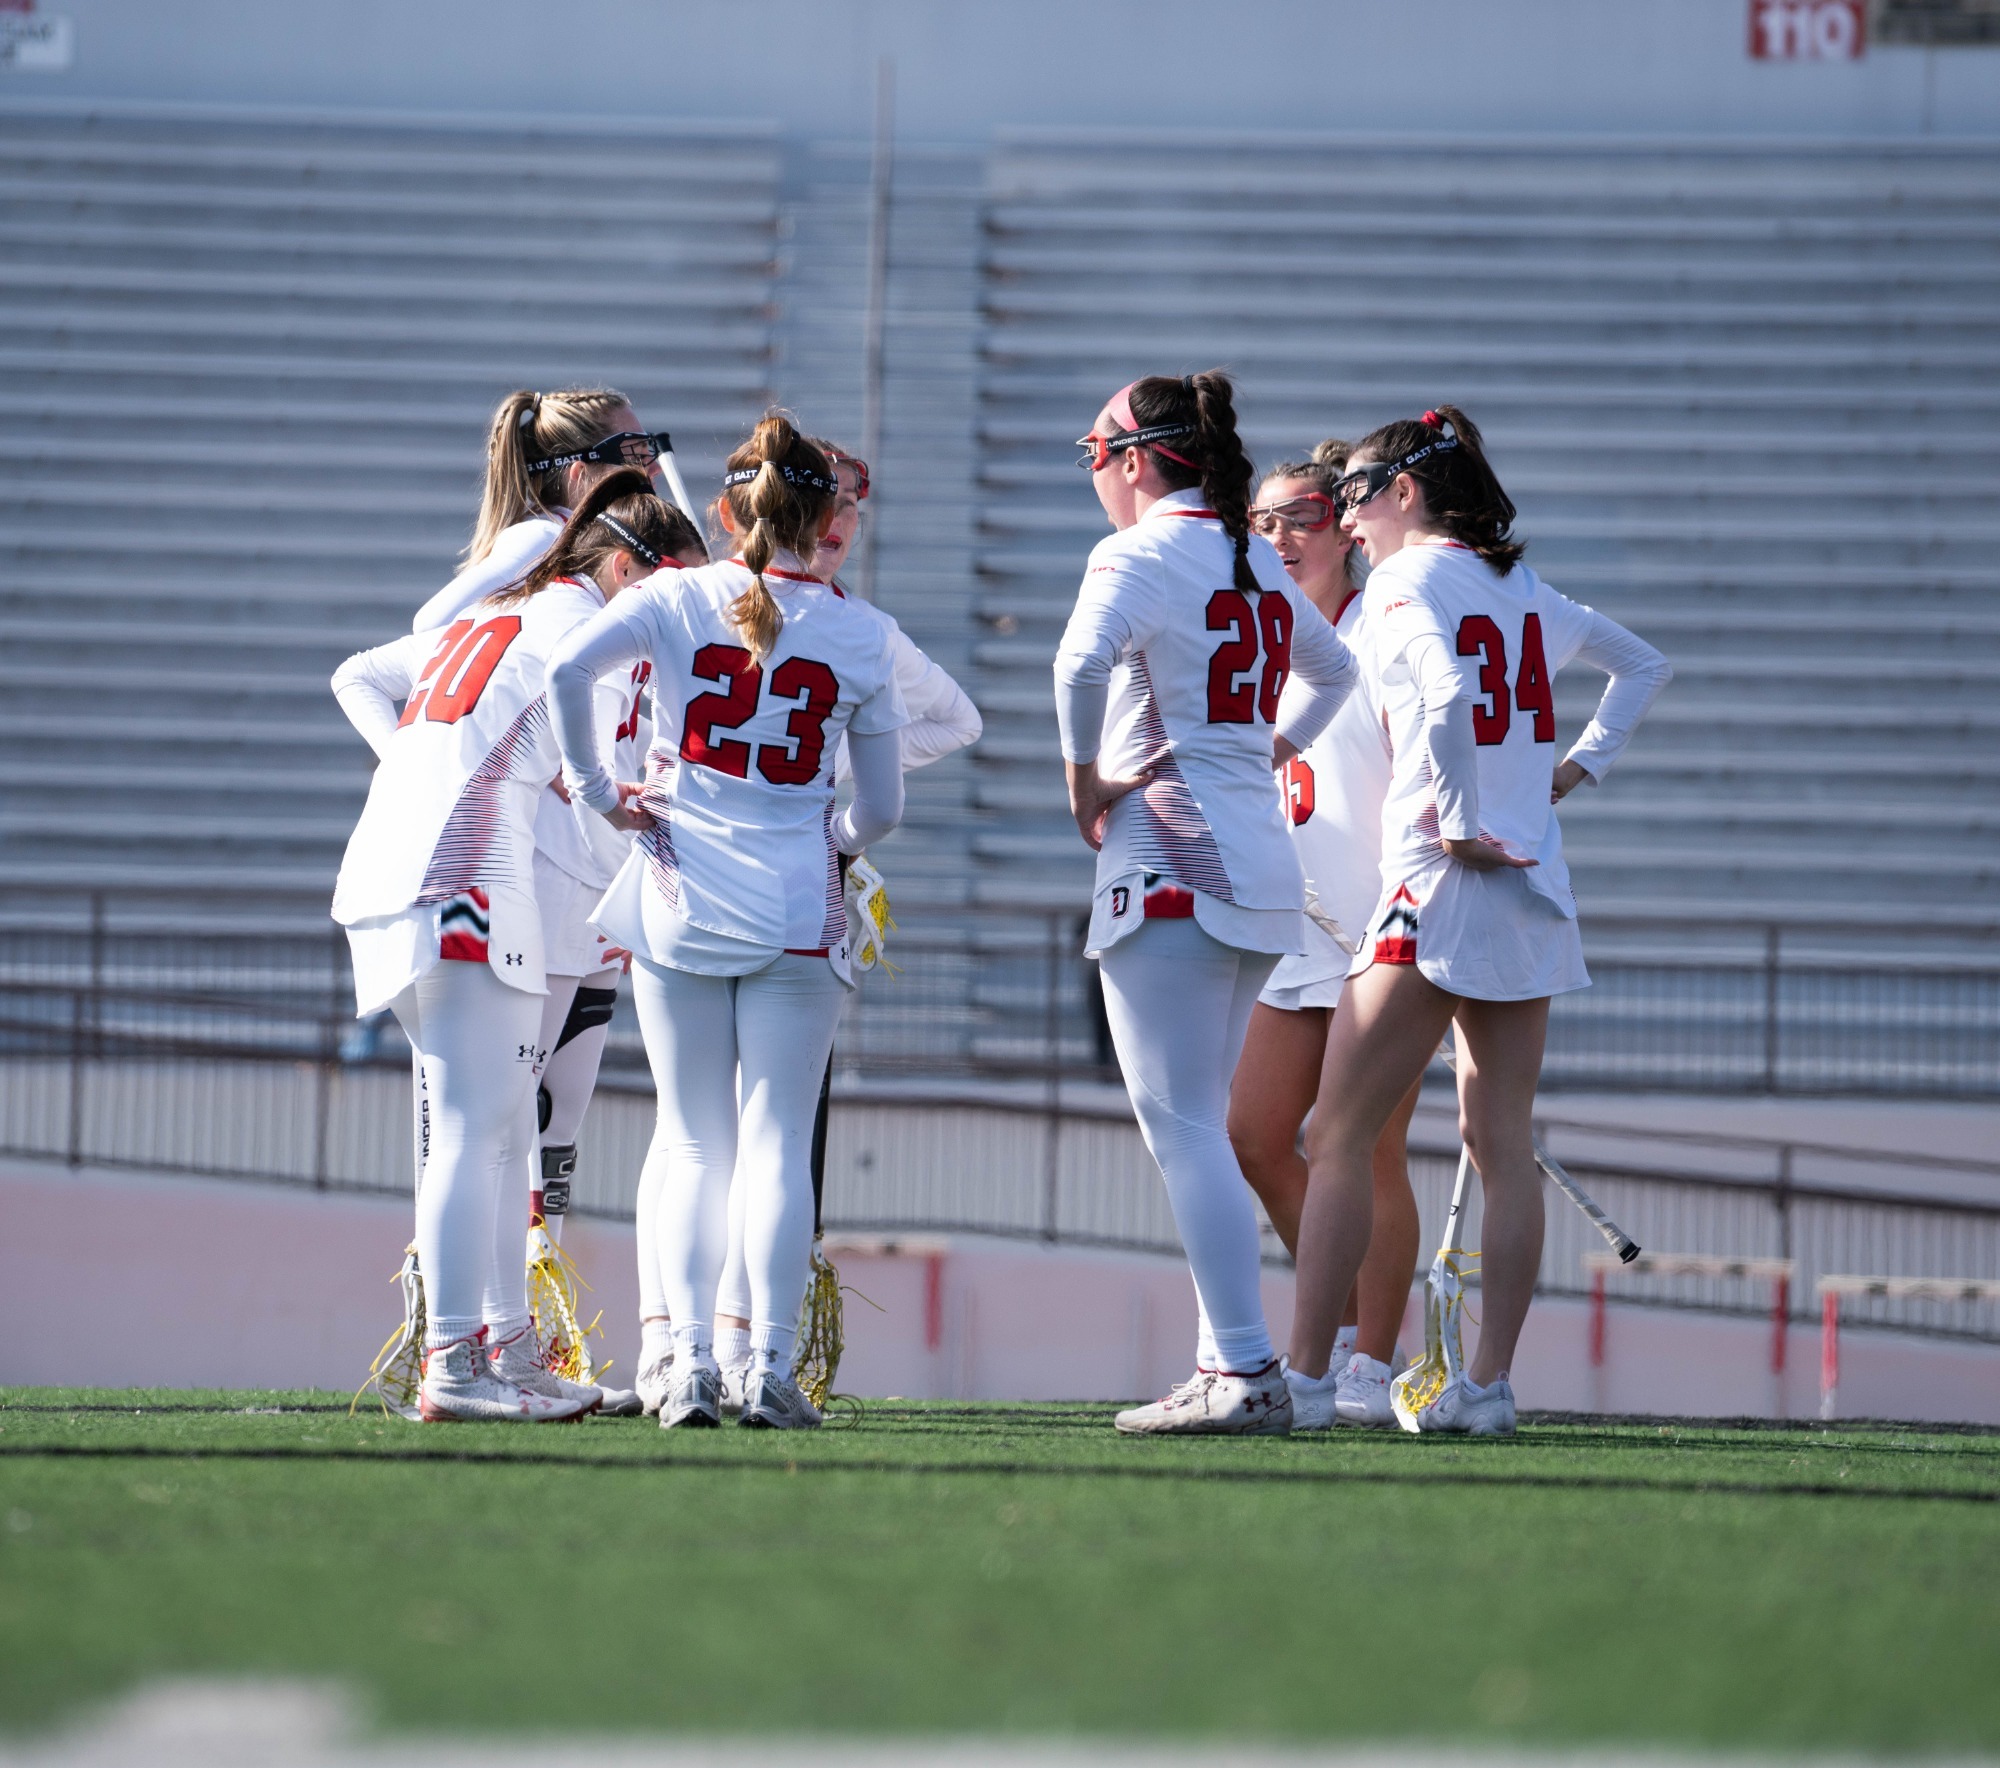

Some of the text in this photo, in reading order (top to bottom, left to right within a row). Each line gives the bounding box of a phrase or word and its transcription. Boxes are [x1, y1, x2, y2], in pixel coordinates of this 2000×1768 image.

[1760, 3, 1857, 58] 110
[554, 453, 582, 466] GAIT
[1108, 428, 1183, 448] UNDER ARMOUR
[1405, 445, 1431, 464] GAIT
[734, 469, 757, 481] GAIT
[604, 518, 638, 546] ARMOUR
[396, 615, 522, 731] 20
[1205, 589, 1294, 724] 28
[1456, 612, 1555, 746] 34
[678, 642, 840, 785] 23
[1282, 744, 1316, 828] 5
[422, 1099, 431, 1167] NDER
